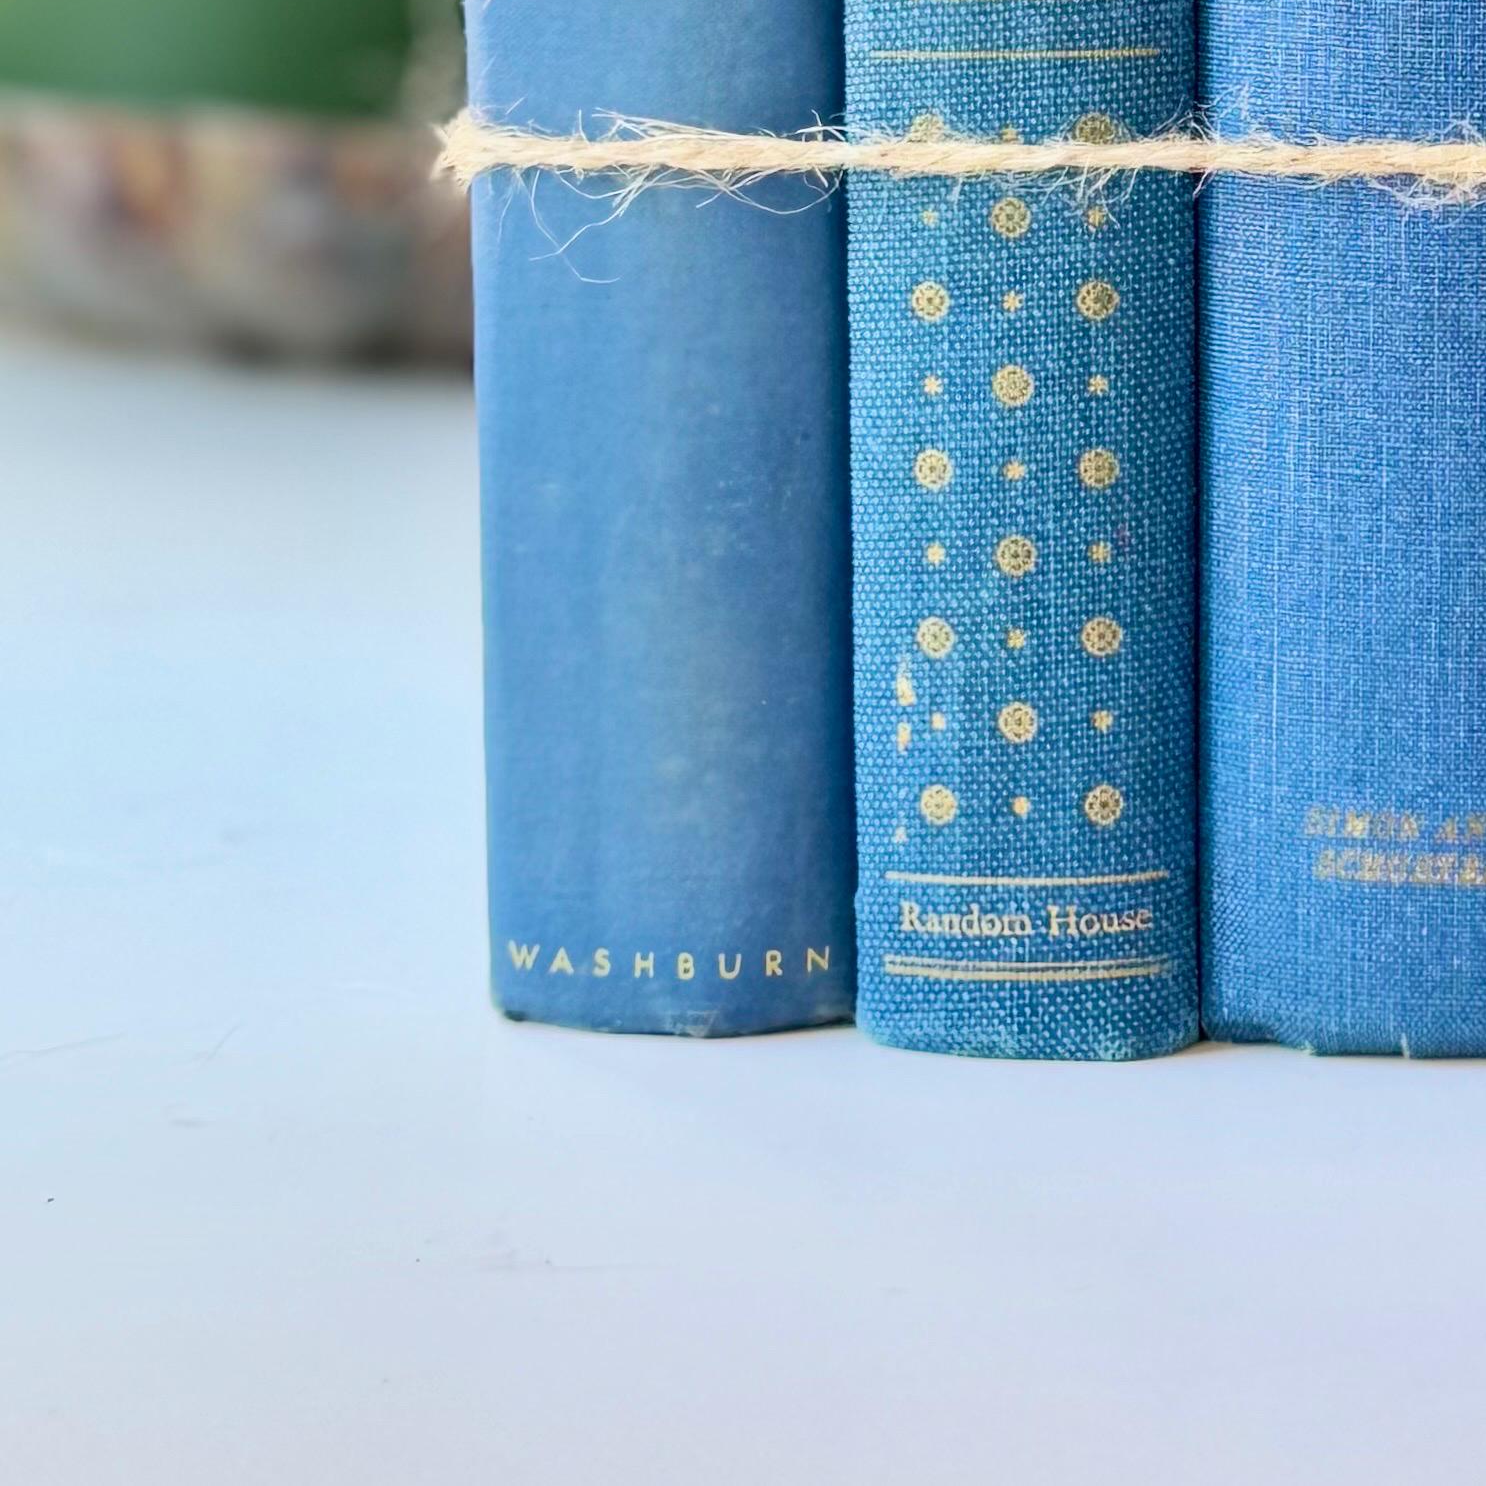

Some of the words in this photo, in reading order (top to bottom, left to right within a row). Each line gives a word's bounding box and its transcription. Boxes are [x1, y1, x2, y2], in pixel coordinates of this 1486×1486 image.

[901, 900, 1034, 937] Random
[1046, 902, 1155, 937] House
[507, 939, 831, 981] WASHBURN
